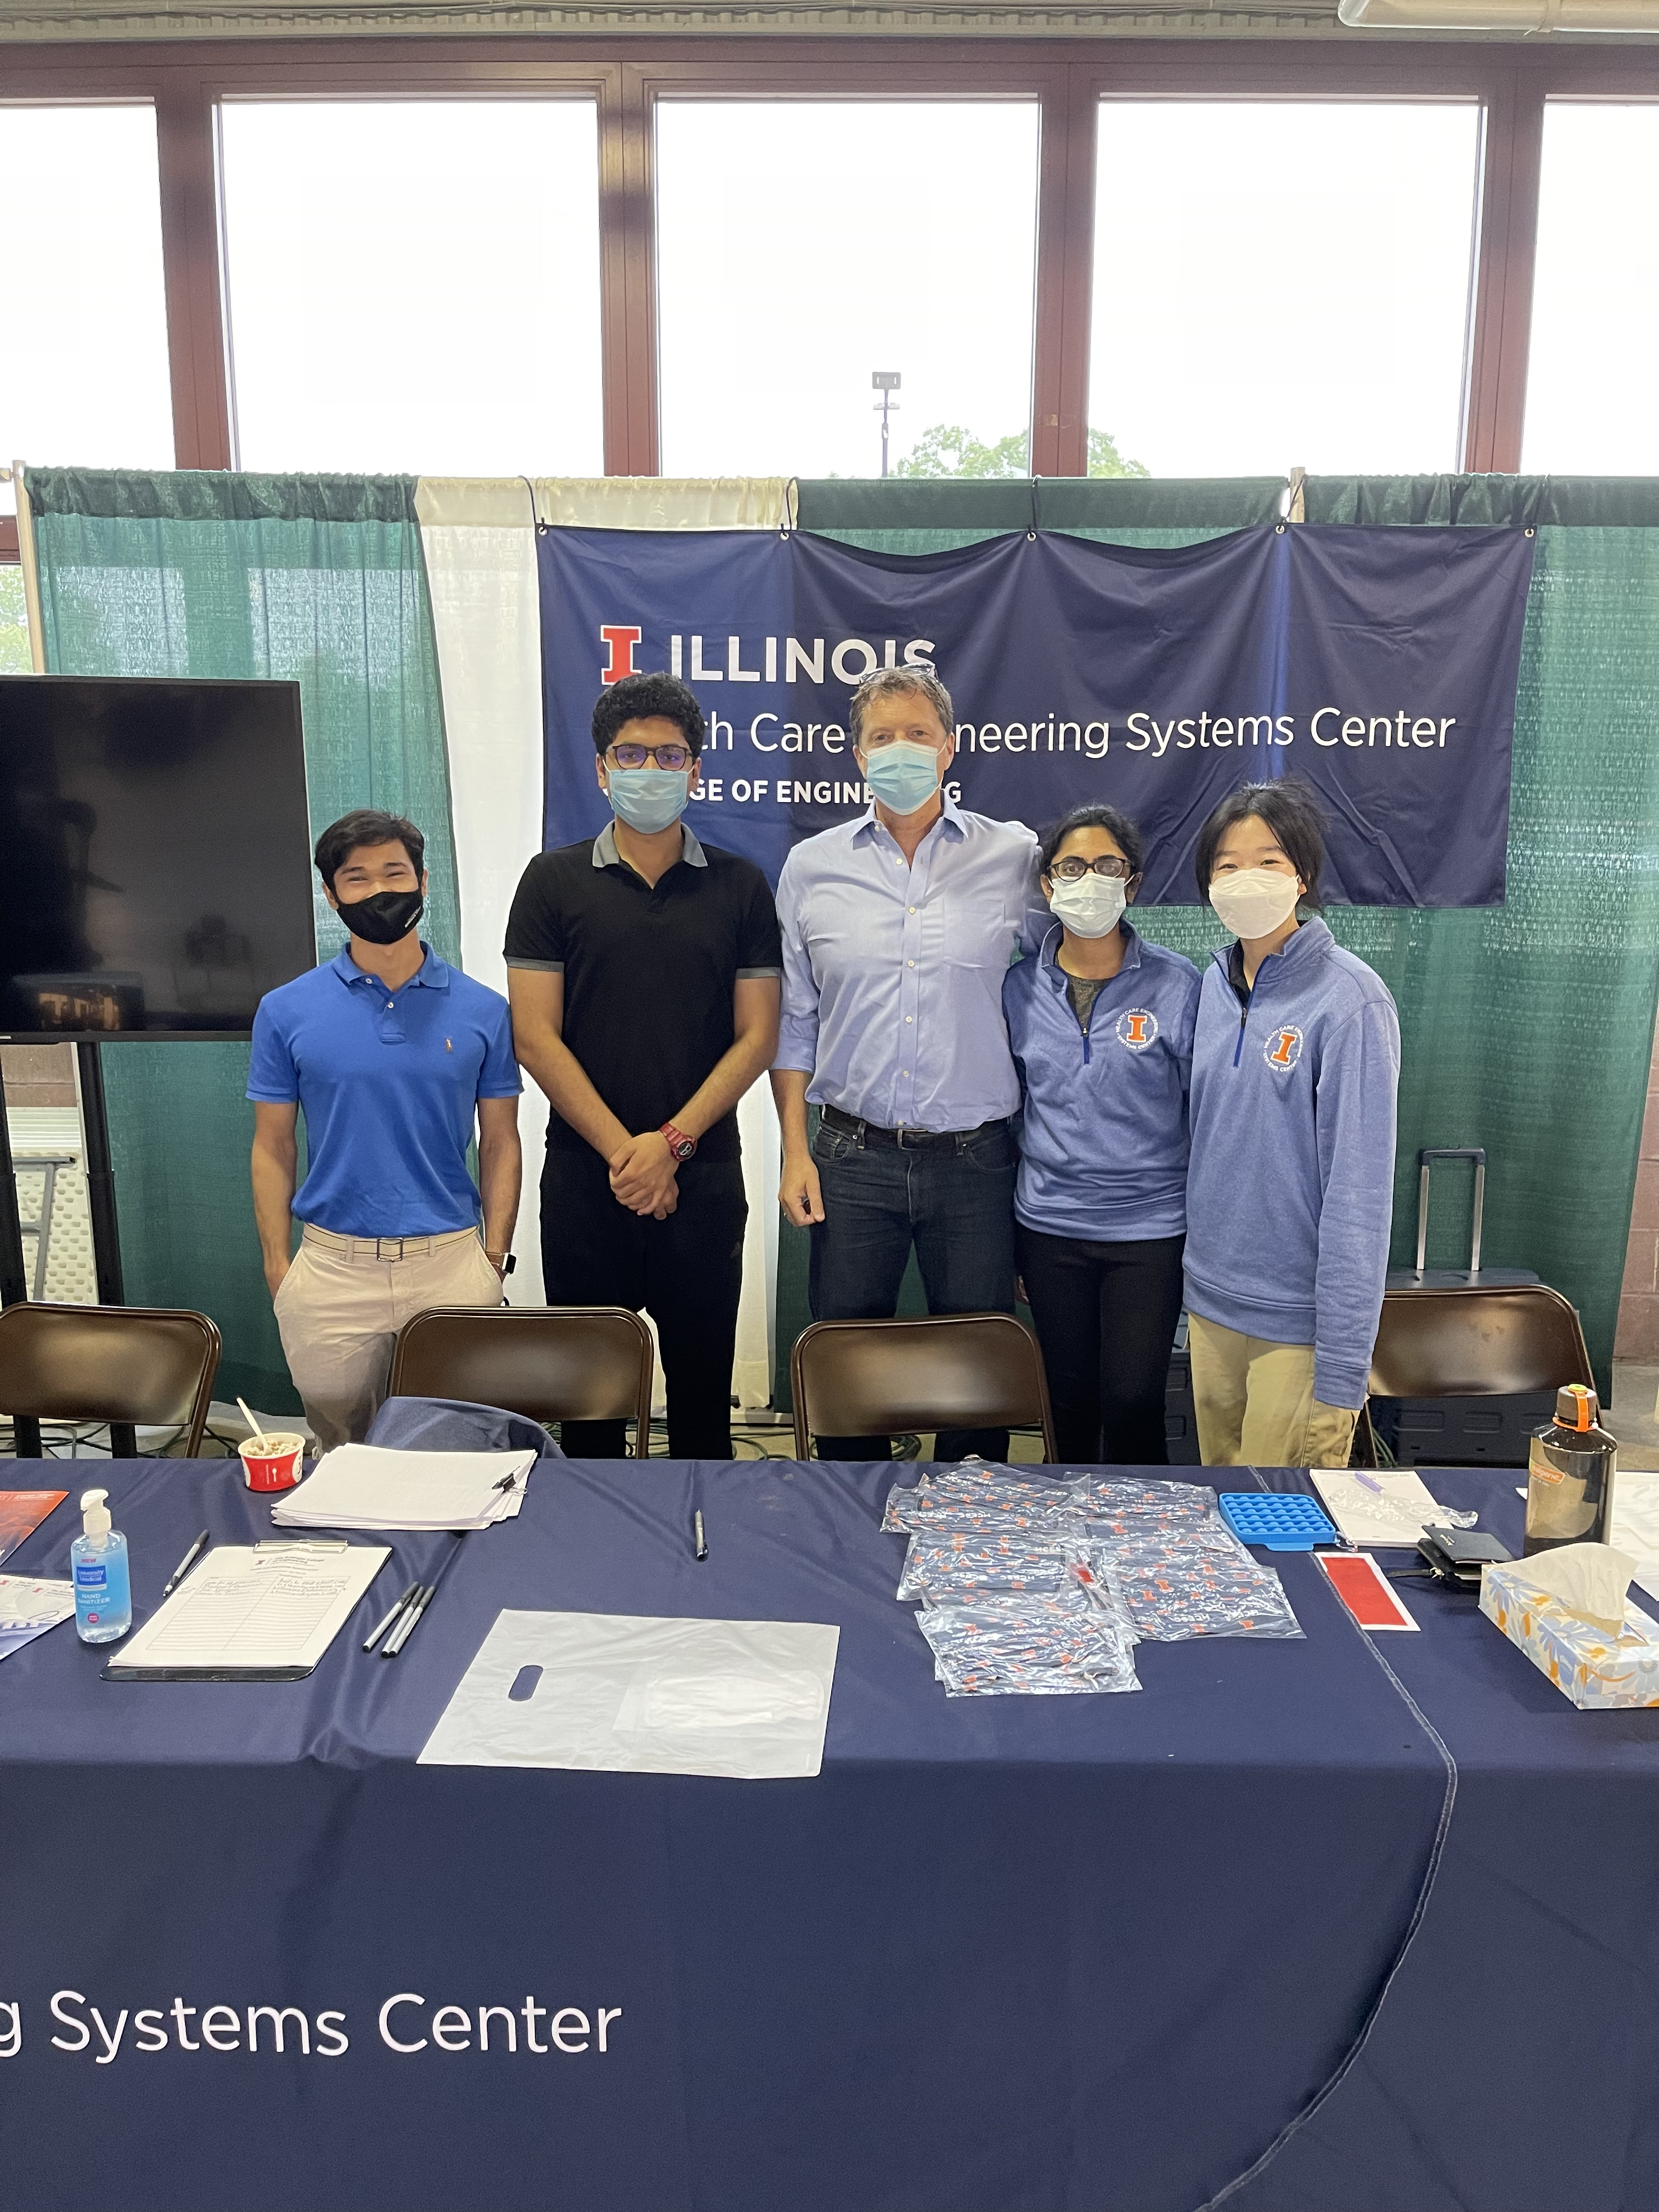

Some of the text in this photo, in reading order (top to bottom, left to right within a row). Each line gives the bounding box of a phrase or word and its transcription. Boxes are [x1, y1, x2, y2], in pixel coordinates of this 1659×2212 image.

[671, 634, 935, 685] ILLINOIS
[751, 713, 845, 753] Care
[955, 713, 1109, 759] neering
[1126, 711, 1294, 757] Systems
[1311, 707, 1457, 748] Center
[731, 779, 769, 803] OF
[1124, 1007, 1140, 1015] CARE
[77, 1597, 111, 1605] SANITIZER
[50, 1990, 349, 2064] Systems
[379, 1993, 622, 2053] Center
